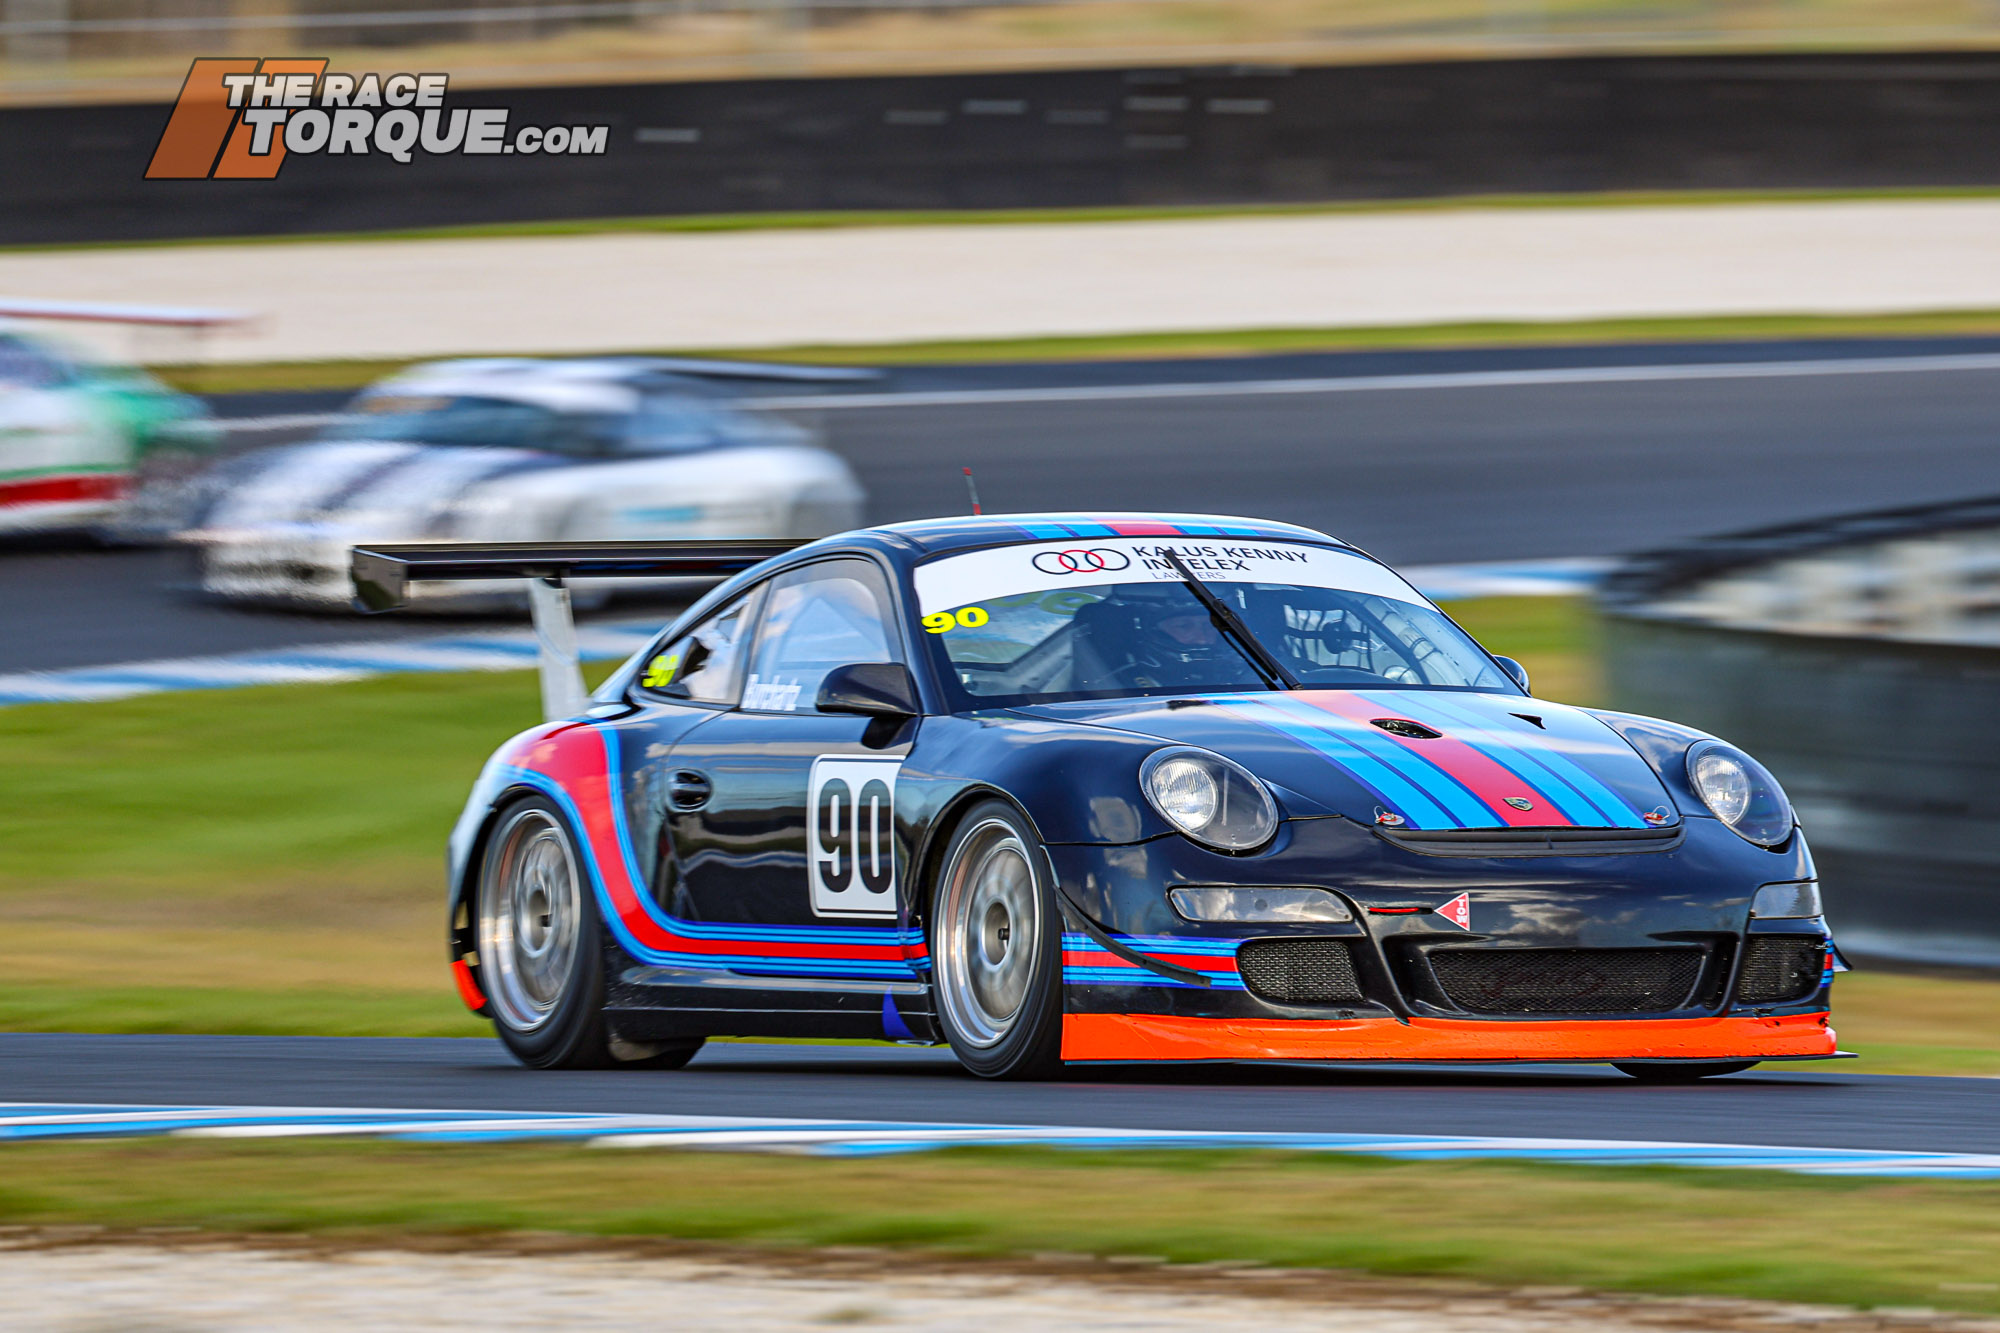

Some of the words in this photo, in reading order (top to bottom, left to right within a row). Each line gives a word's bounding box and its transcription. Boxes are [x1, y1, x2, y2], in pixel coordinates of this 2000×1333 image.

[1131, 546, 1218, 557] KALUS
[1222, 546, 1308, 563] KENNY
[1151, 571, 1226, 580] LAWERS
[921, 606, 989, 634] 90
[818, 777, 893, 894] 90
[1456, 899, 1468, 923] TOW
